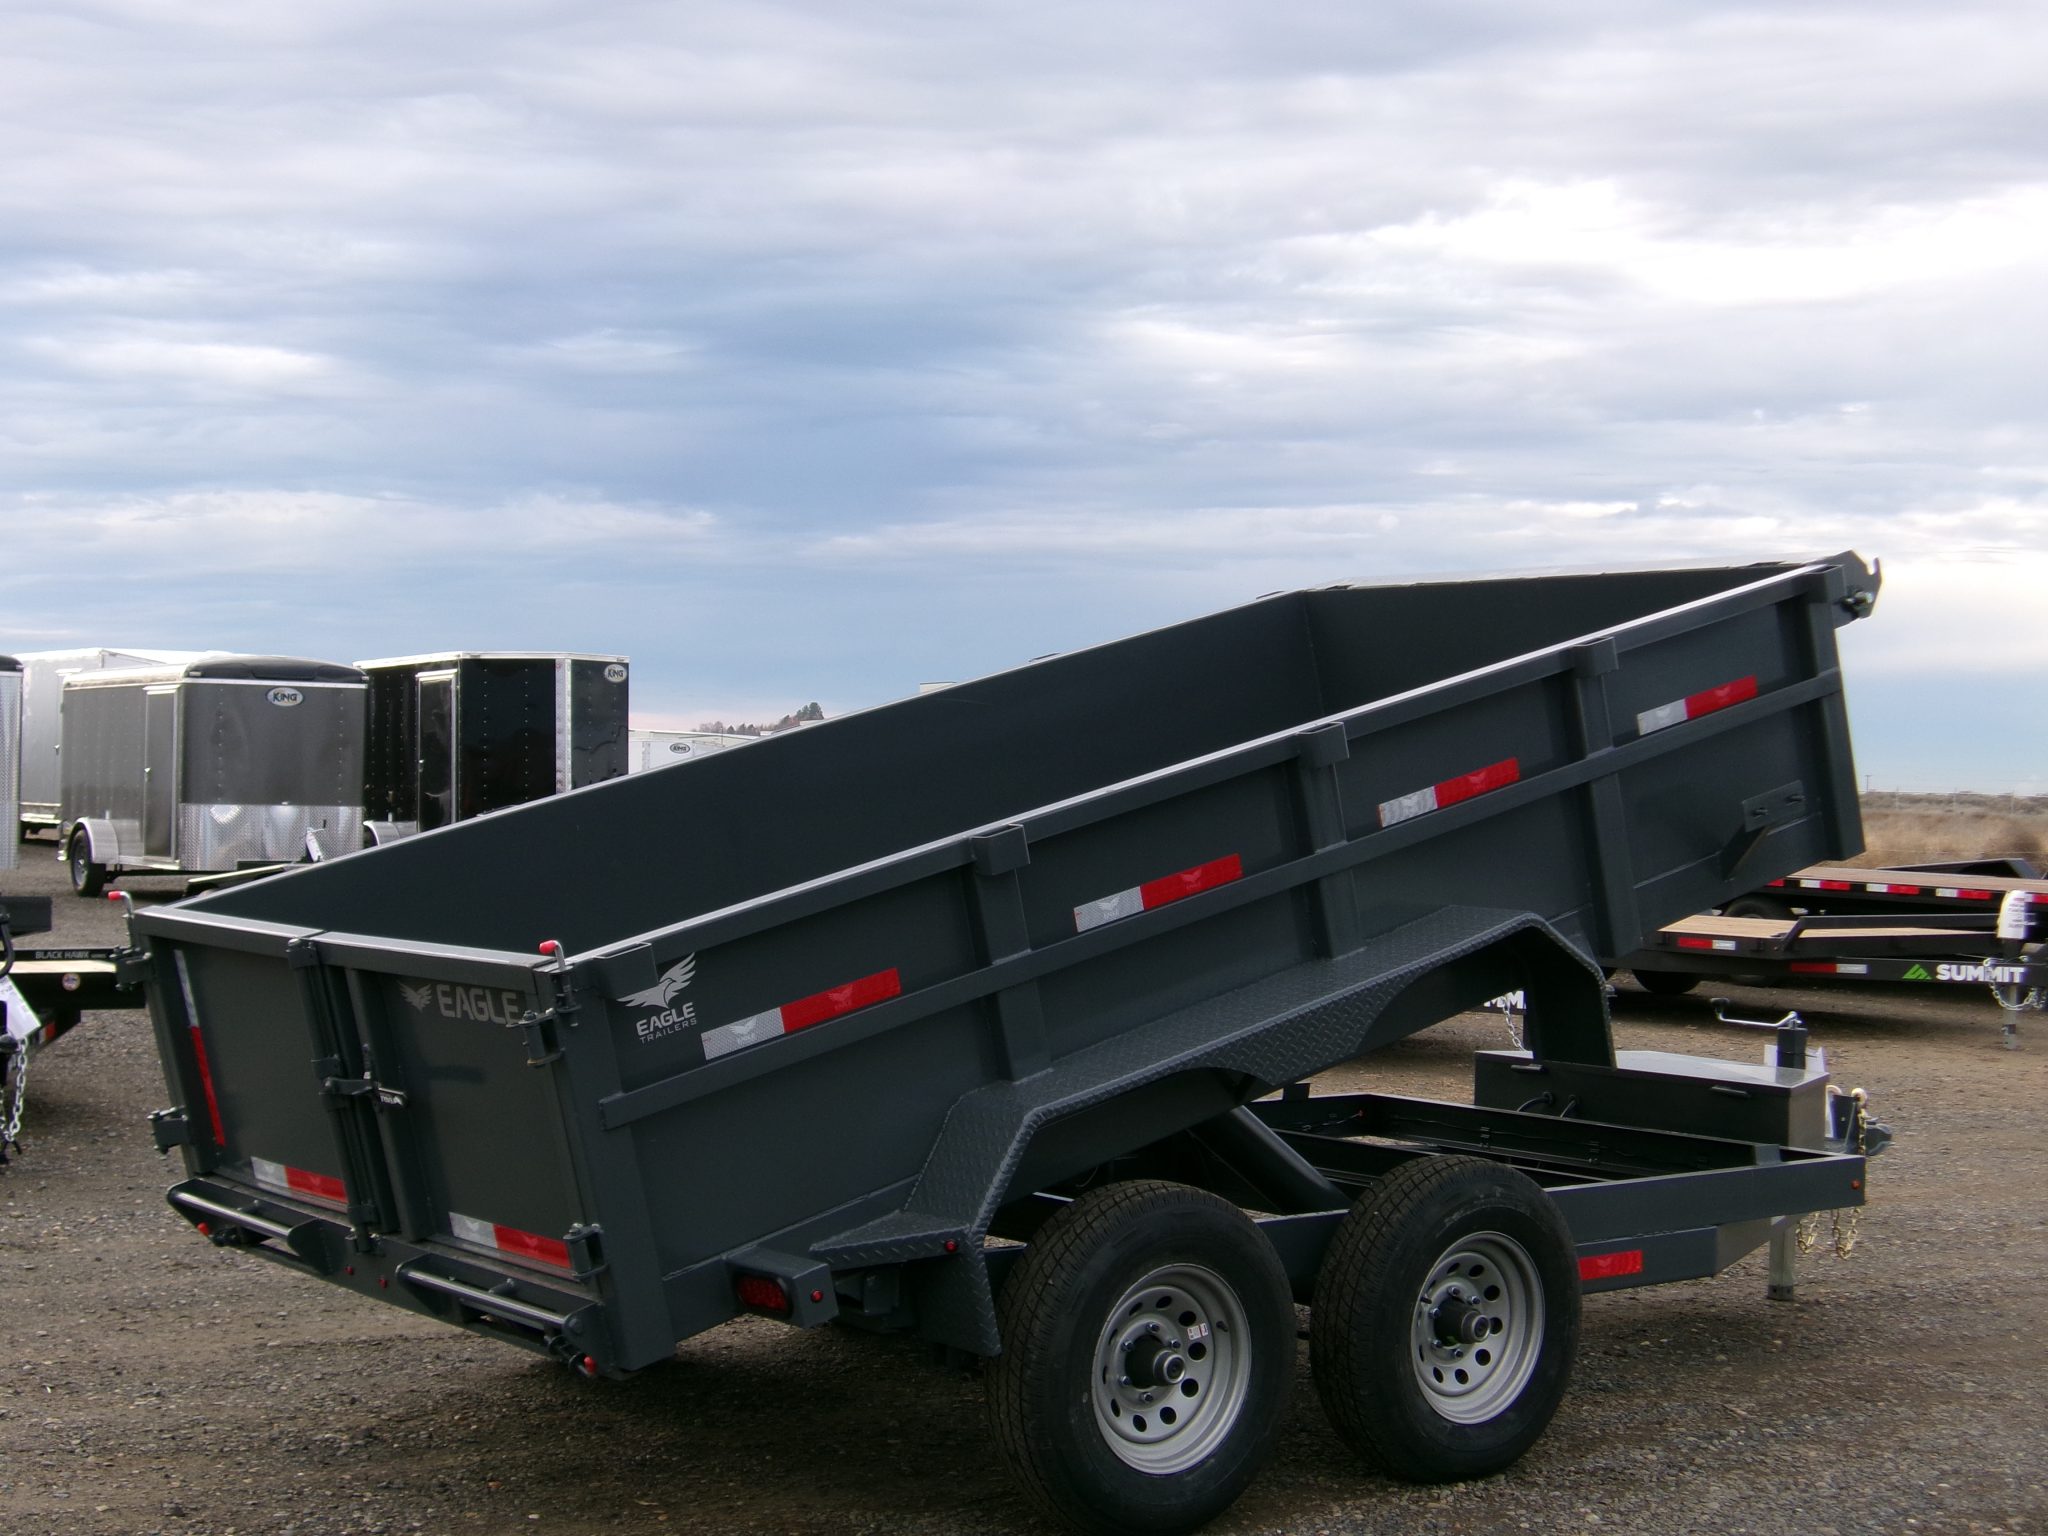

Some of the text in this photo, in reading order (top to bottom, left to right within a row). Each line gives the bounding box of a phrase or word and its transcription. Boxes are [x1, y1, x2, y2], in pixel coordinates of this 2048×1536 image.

[272, 691, 298, 702] KING
[35, 951, 62, 959] BLACK
[64, 951, 89, 959] HAWK
[1935, 964, 2025, 983] SUMMIT
[436, 983, 520, 1026] EAGLE
[635, 1001, 696, 1036] EAGLE
[639, 1017, 697, 1045] TRAILERS
